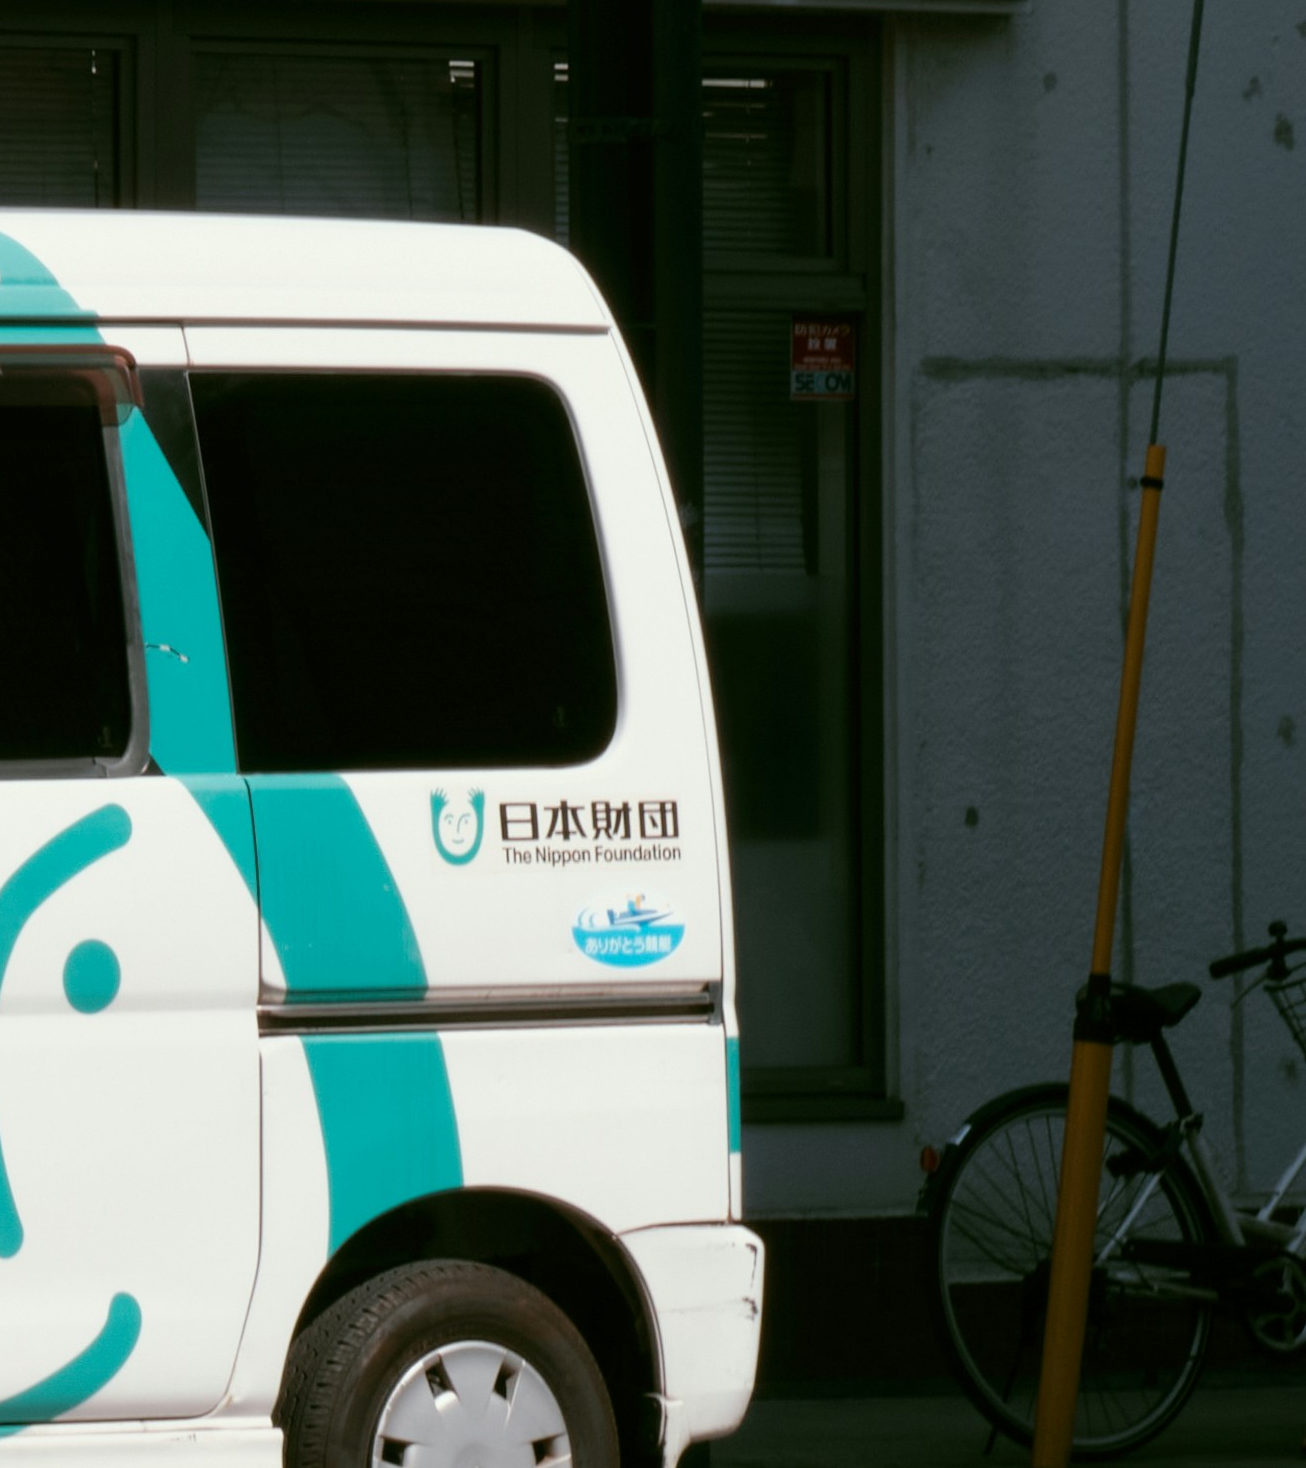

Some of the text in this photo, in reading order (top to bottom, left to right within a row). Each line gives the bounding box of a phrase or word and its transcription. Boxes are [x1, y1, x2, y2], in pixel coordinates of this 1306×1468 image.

[795, 373, 851, 391] SECOM
[499, 800, 680, 842] 日本財団
[502, 845, 682, 867] The Nippon Foundation
